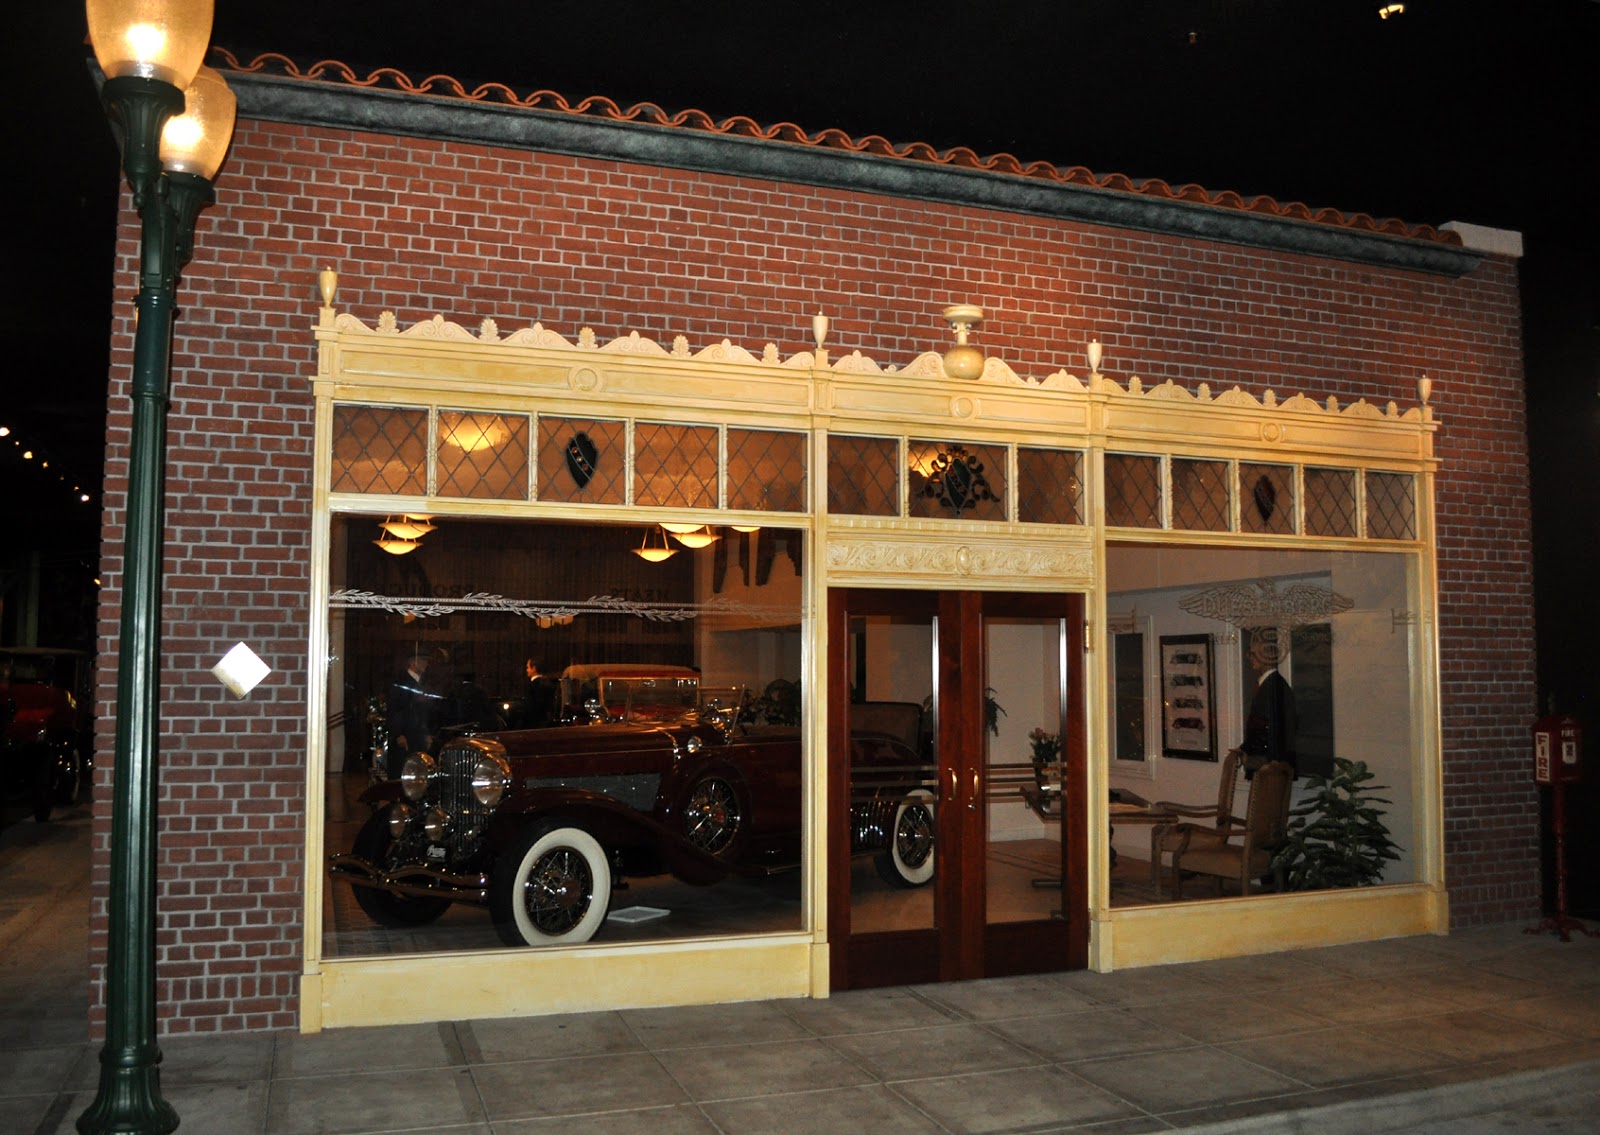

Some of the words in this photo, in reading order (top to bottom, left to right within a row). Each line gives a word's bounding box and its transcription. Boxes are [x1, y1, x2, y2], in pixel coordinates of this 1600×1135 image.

[1202, 594, 1332, 616] DUESENBERG
[1561, 729, 1575, 737] FIRE
[1537, 734, 1548, 779] FIRE
